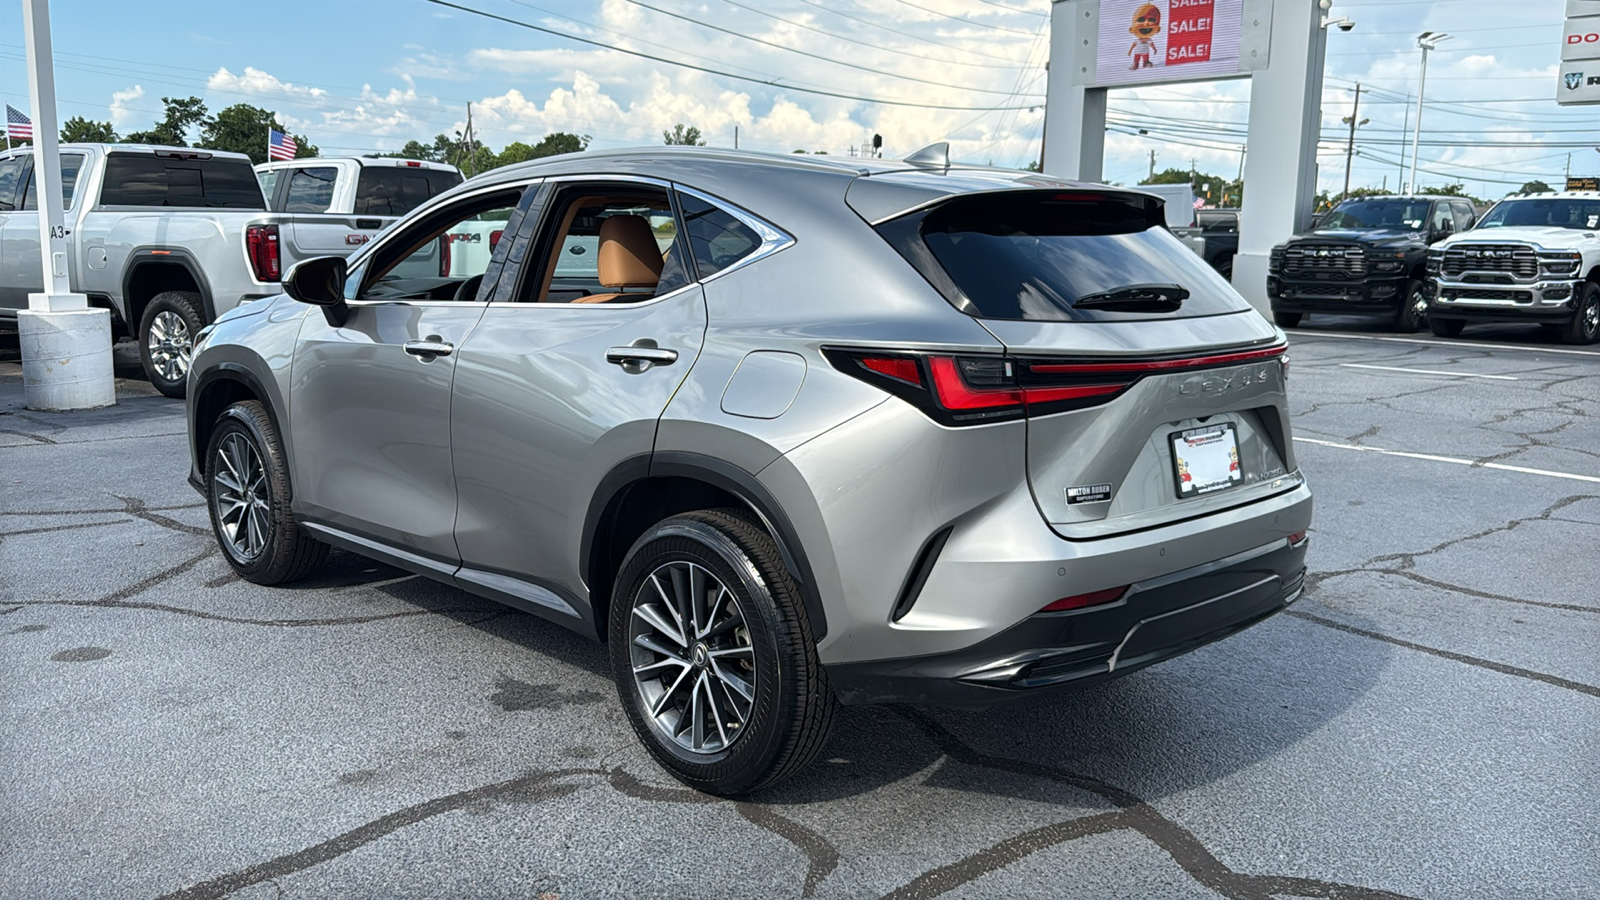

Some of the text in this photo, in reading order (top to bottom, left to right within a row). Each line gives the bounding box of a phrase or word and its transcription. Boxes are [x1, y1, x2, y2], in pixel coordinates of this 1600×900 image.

[1169, 18, 1211, 34] SALE!
[1168, 44, 1209, 60] SALE!
[50, 225, 64, 239] A3
[450, 232, 481, 244] FX4
[1304, 249, 1345, 258] RAM
[1466, 249, 1512, 258] RAM
[1179, 371, 1267, 394] LEXUS
